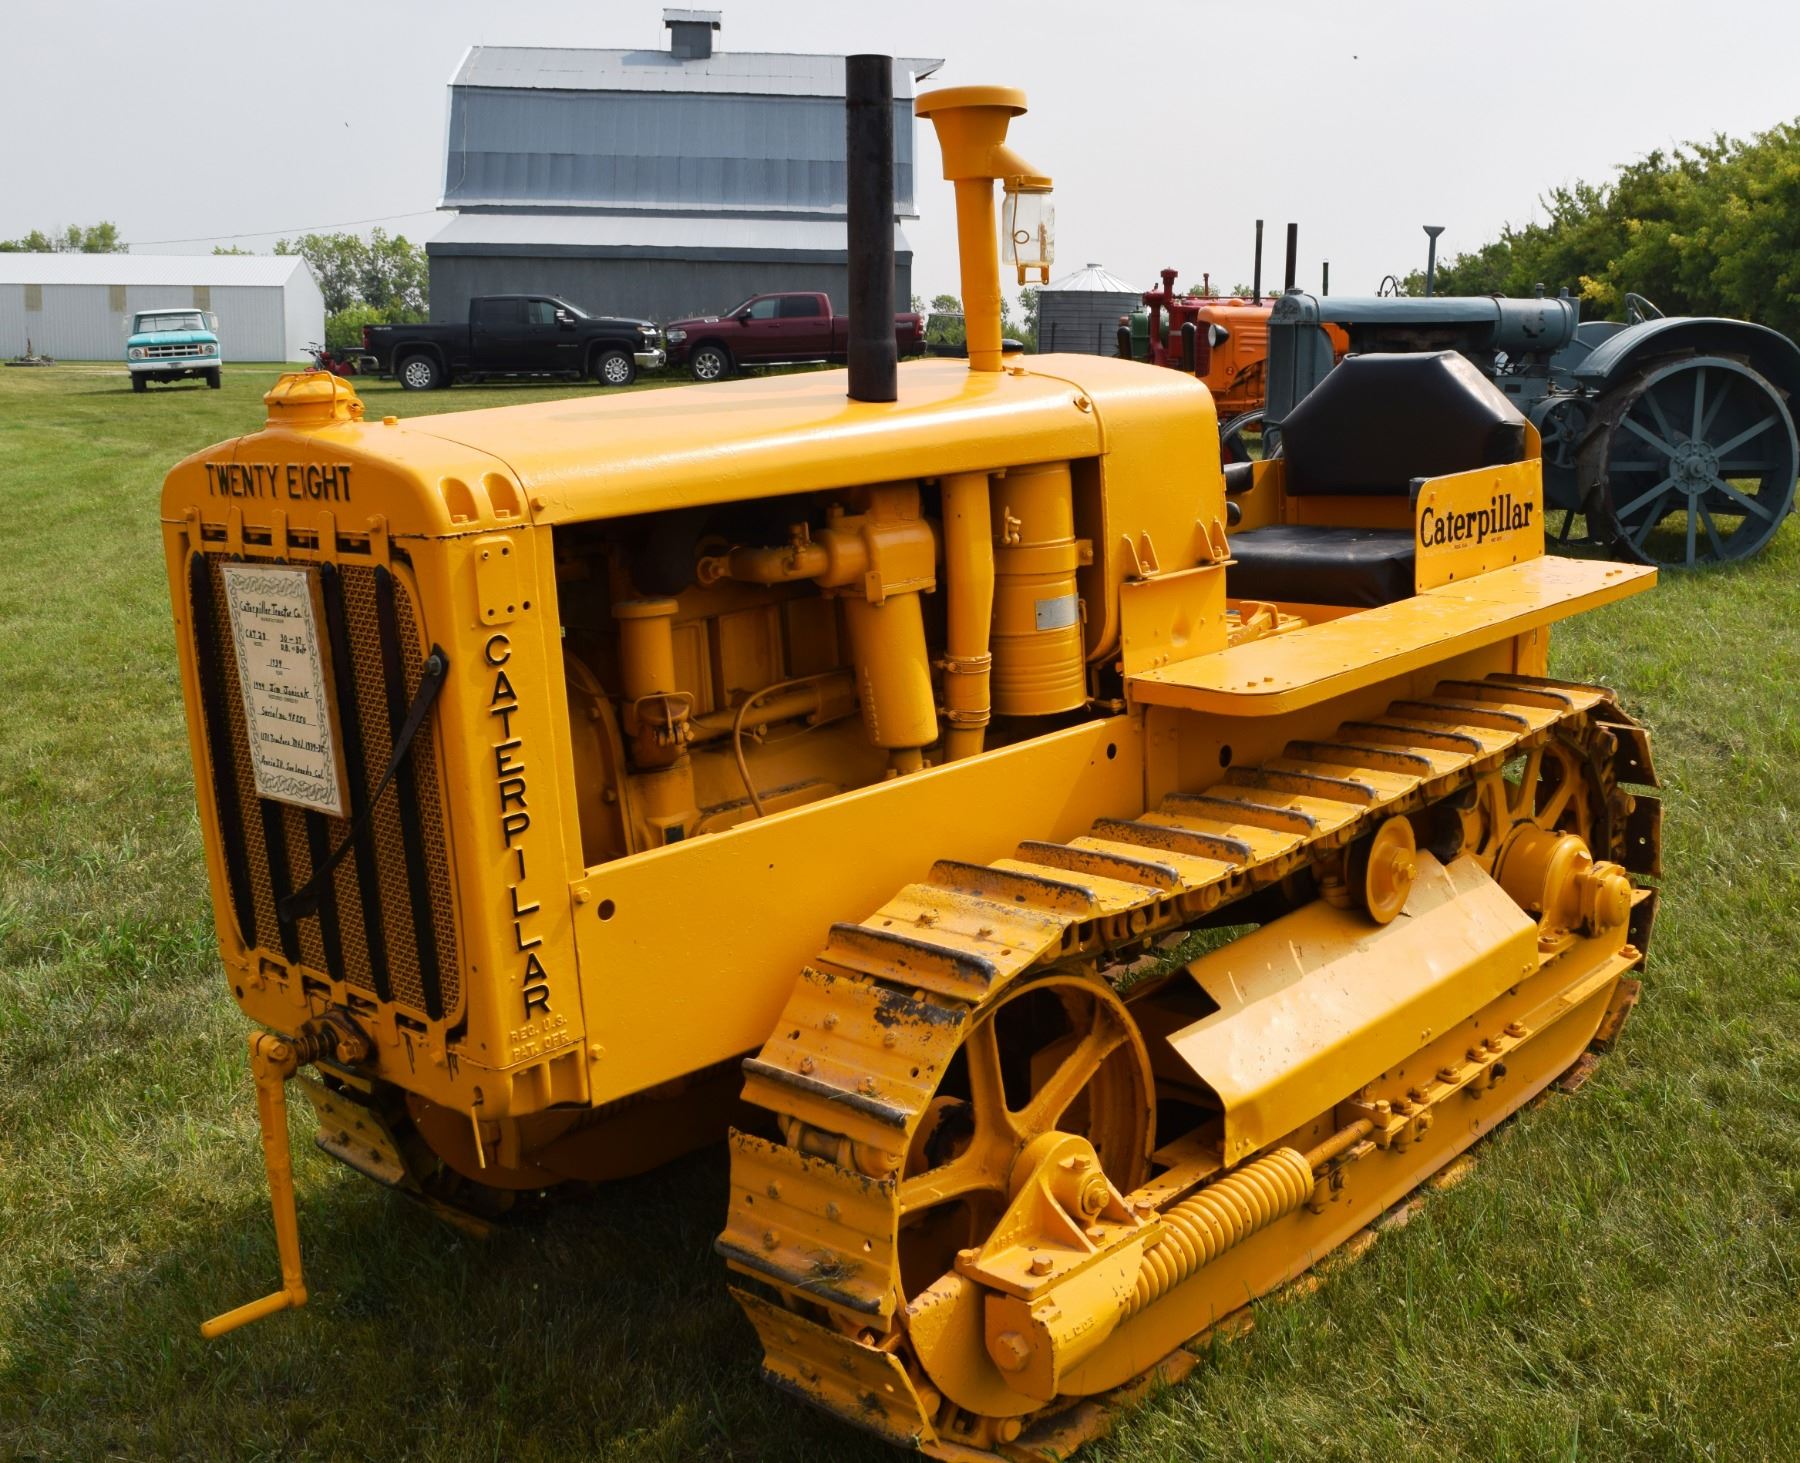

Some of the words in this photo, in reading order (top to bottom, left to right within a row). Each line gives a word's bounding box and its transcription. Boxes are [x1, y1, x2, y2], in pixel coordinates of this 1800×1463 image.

[205, 462, 279, 499] TWENTY
[286, 462, 352, 502] EIGHT
[1420, 493, 1533, 548] Caterpillar
[484, 633, 551, 1020] CATERPILLAR
